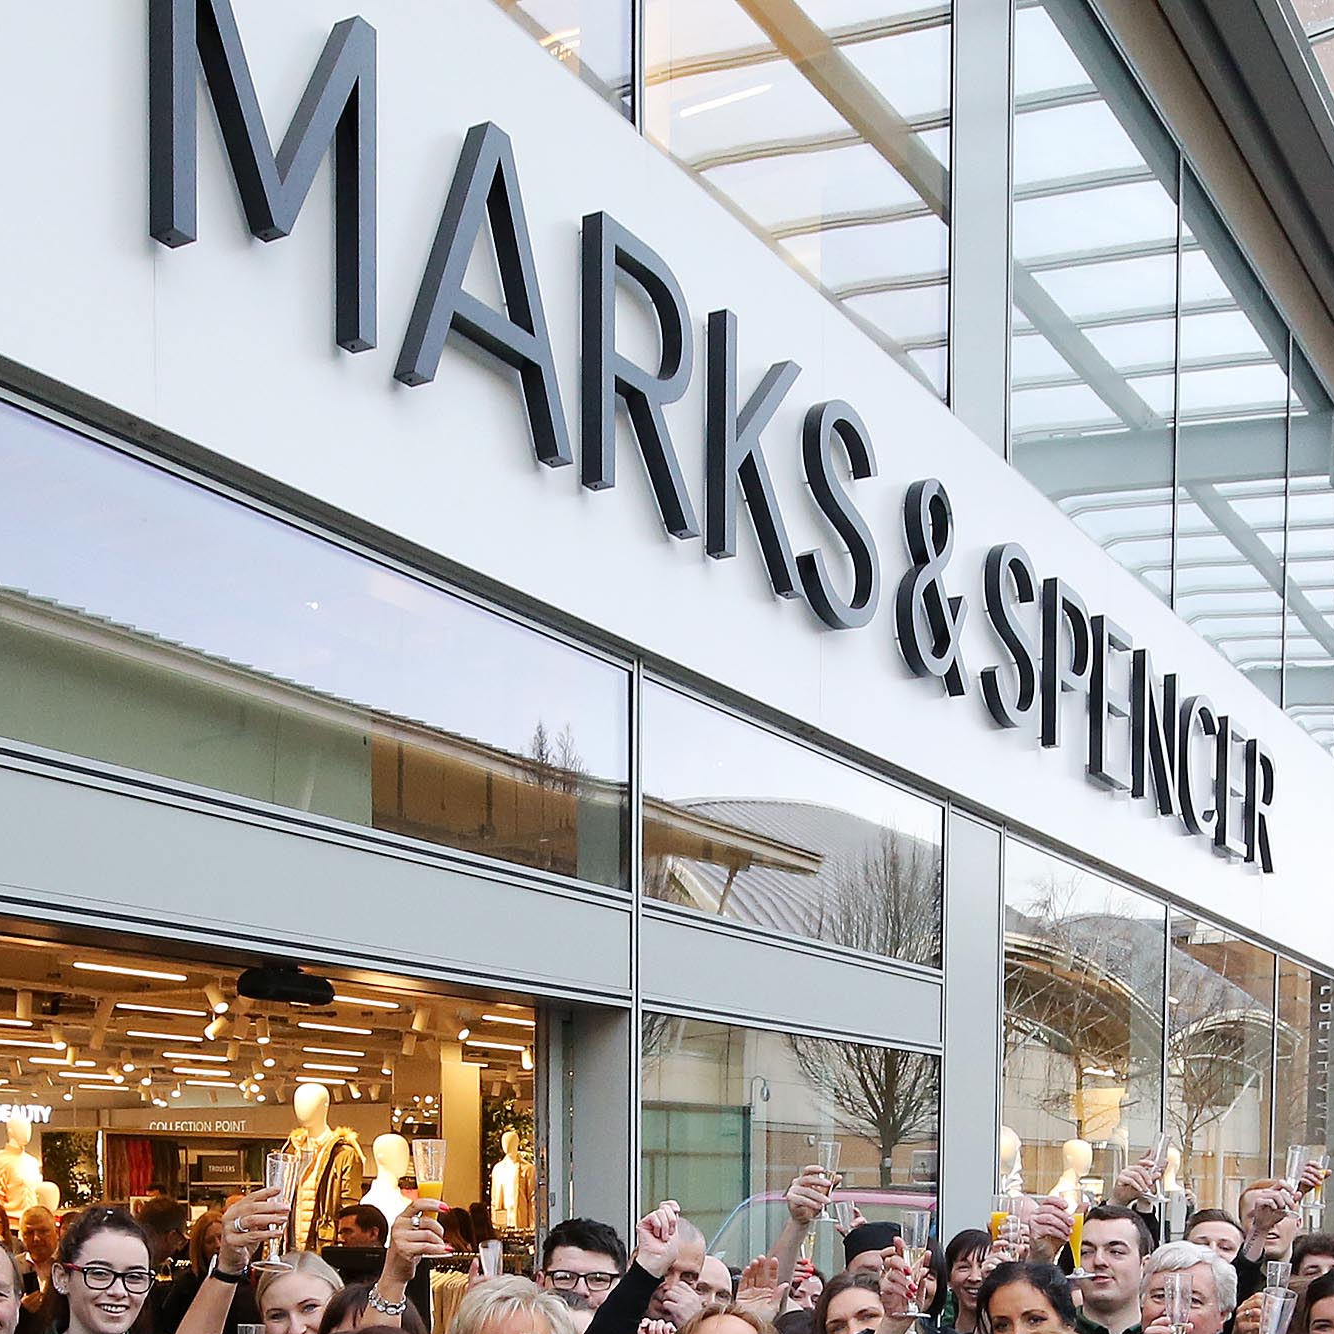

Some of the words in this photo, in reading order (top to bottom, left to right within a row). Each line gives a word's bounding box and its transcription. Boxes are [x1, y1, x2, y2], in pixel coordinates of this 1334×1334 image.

[149, 0, 880, 630] MARKS
[896, 477, 966, 698] &
[980, 541, 1275, 875] SPENCER
[149, 1121, 212, 1132] COLLECTION
[215, 1120, 246, 1132] POINT
[208, 1165, 235, 1173] TROUSERS
